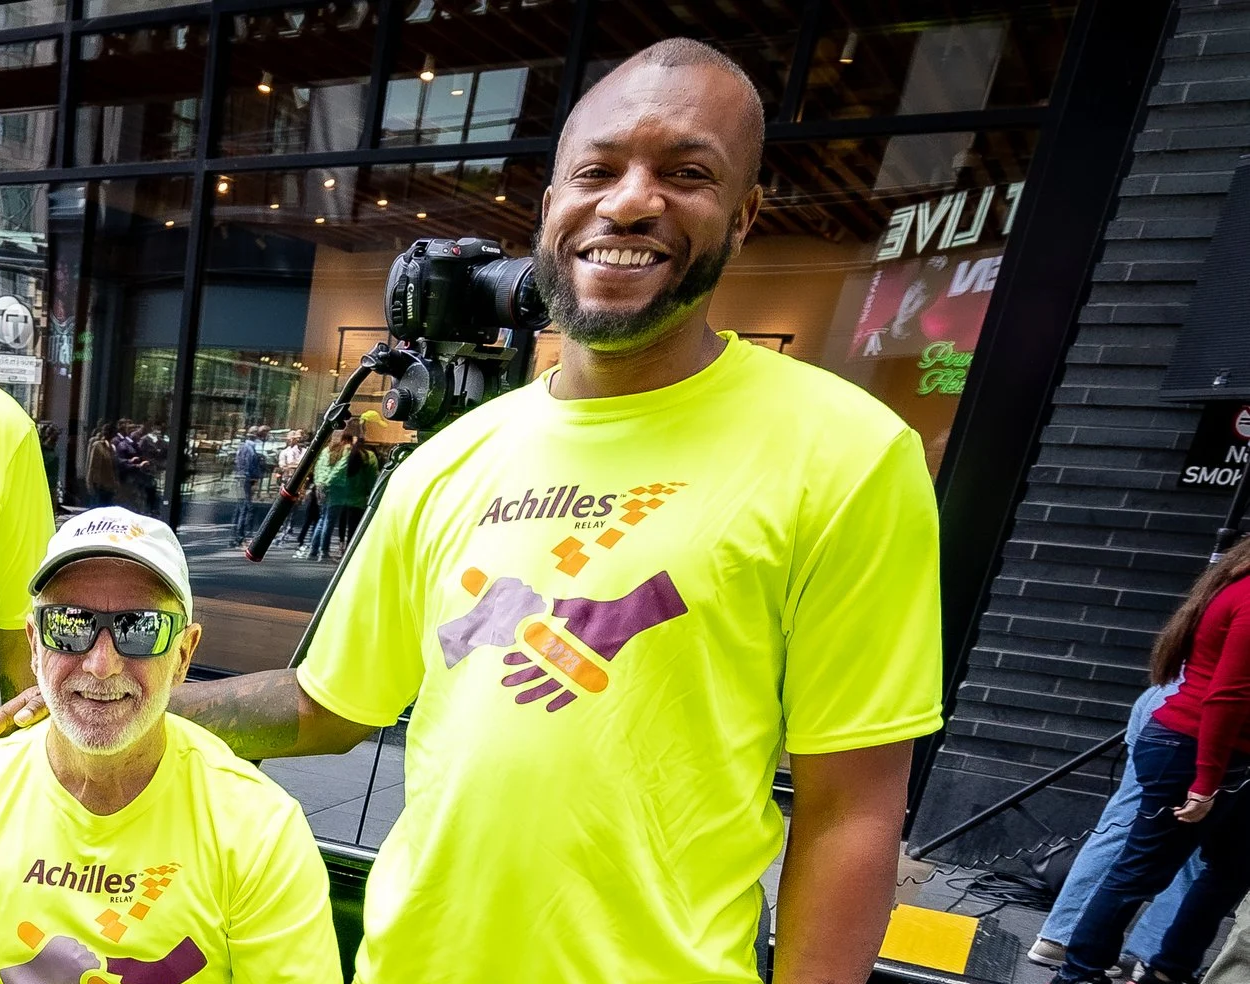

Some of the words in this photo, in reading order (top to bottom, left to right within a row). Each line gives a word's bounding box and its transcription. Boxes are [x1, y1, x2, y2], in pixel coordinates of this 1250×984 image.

[481, 245, 501, 254] Canon
[406, 283, 415, 319] Canon
[478, 484, 617, 527] Achilles
[574, 520, 606, 530] RELAY
[541, 637, 581, 673] 2023
[23, 859, 137, 894] Achilles
[109, 895, 134, 904] RELAY
